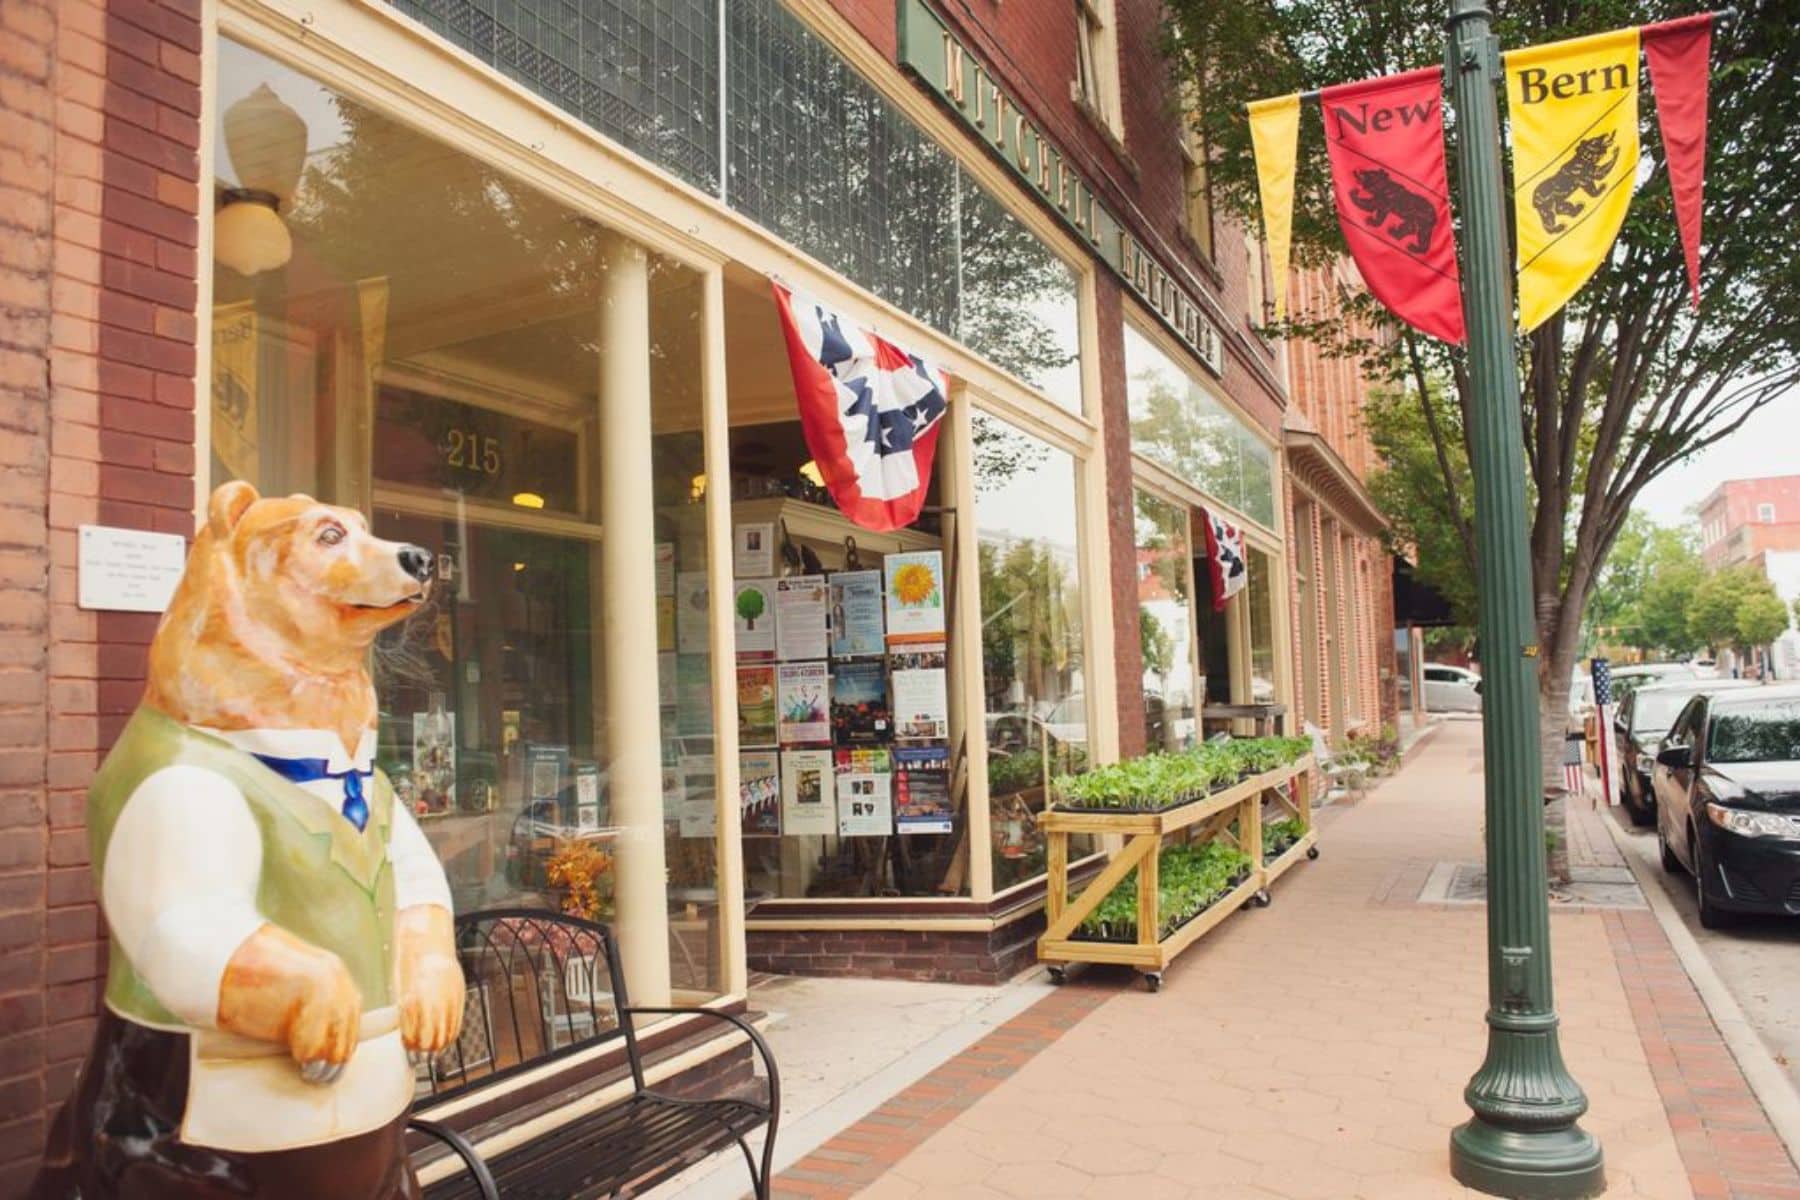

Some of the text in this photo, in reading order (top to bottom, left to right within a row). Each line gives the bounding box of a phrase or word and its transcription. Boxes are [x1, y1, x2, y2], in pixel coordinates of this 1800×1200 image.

[1519, 62, 1630, 105] Bern
[943, 31, 1101, 245] MITCHELL
[1335, 99, 1436, 139] New
[448, 429, 500, 475] 215
